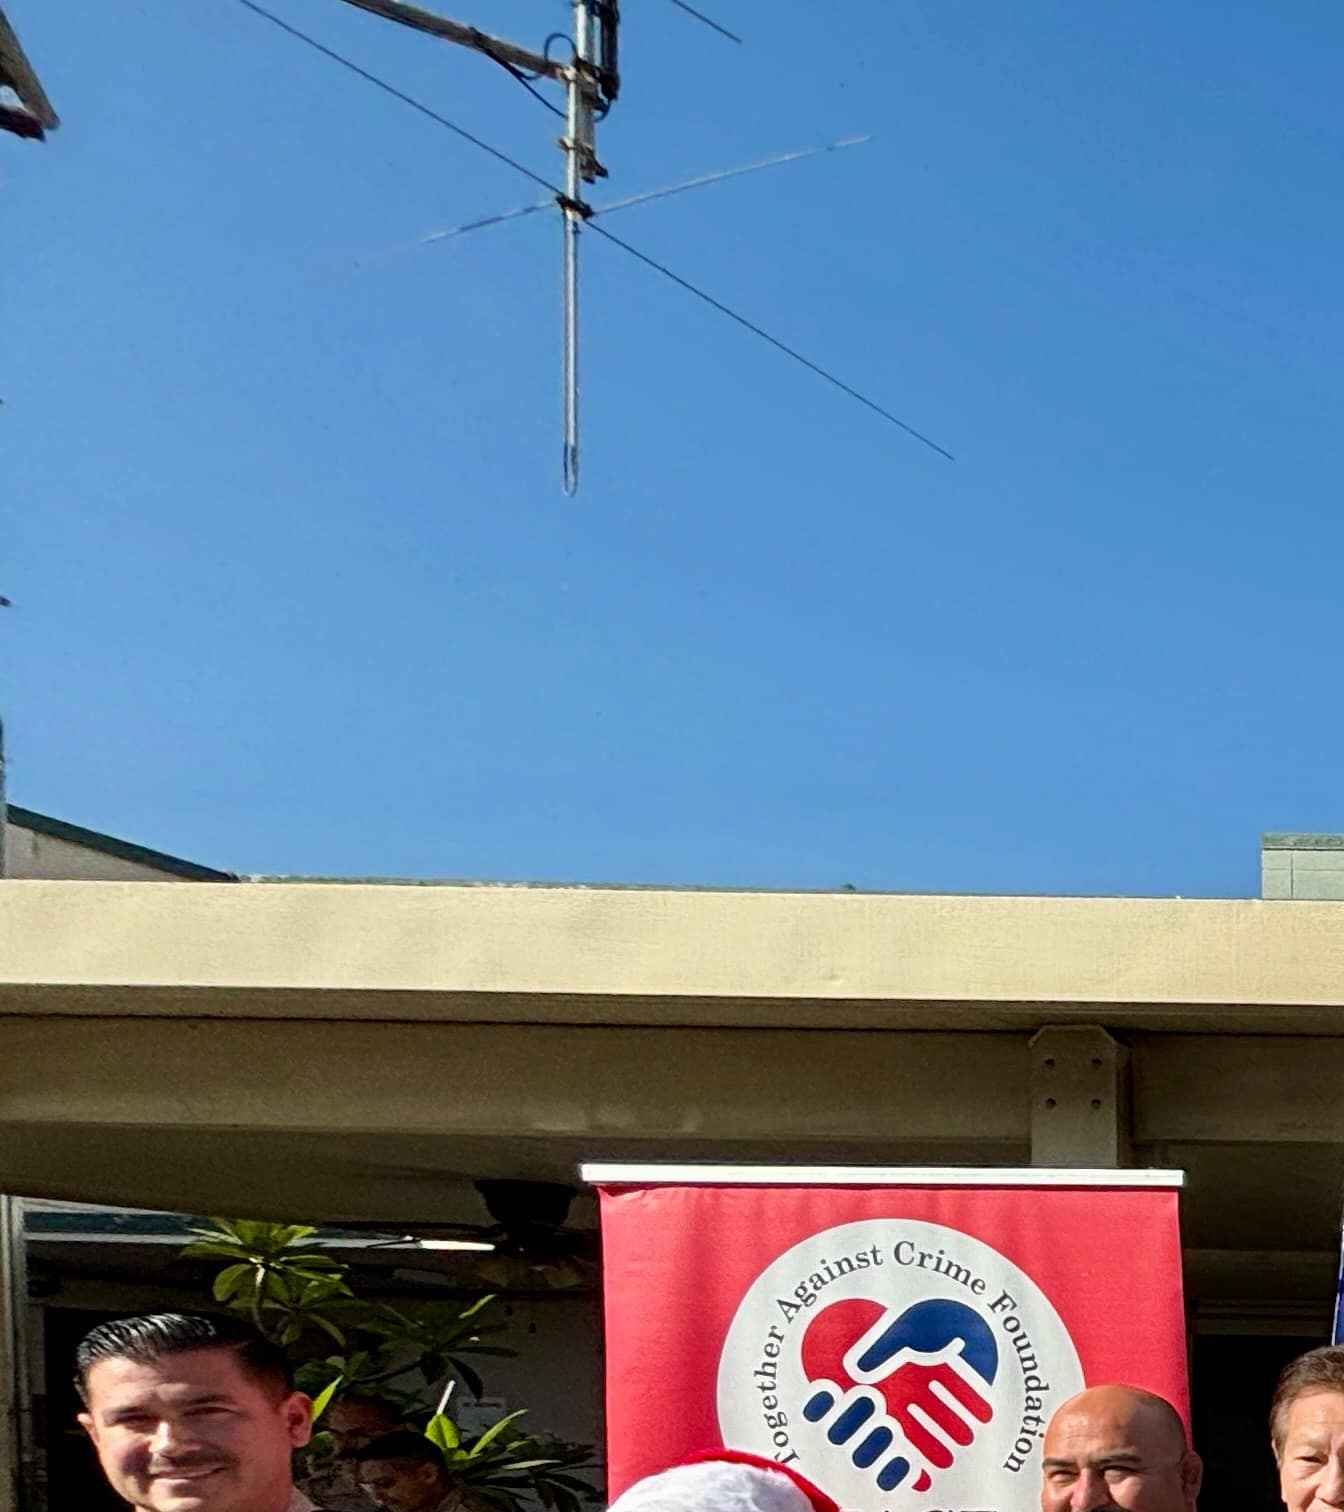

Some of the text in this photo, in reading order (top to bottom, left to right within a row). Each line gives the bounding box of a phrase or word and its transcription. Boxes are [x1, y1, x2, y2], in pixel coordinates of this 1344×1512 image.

[776, 1243, 884, 1325] Against
[893, 1240, 987, 1296] Crime
[986, 1289, 1050, 1474] Foundation
